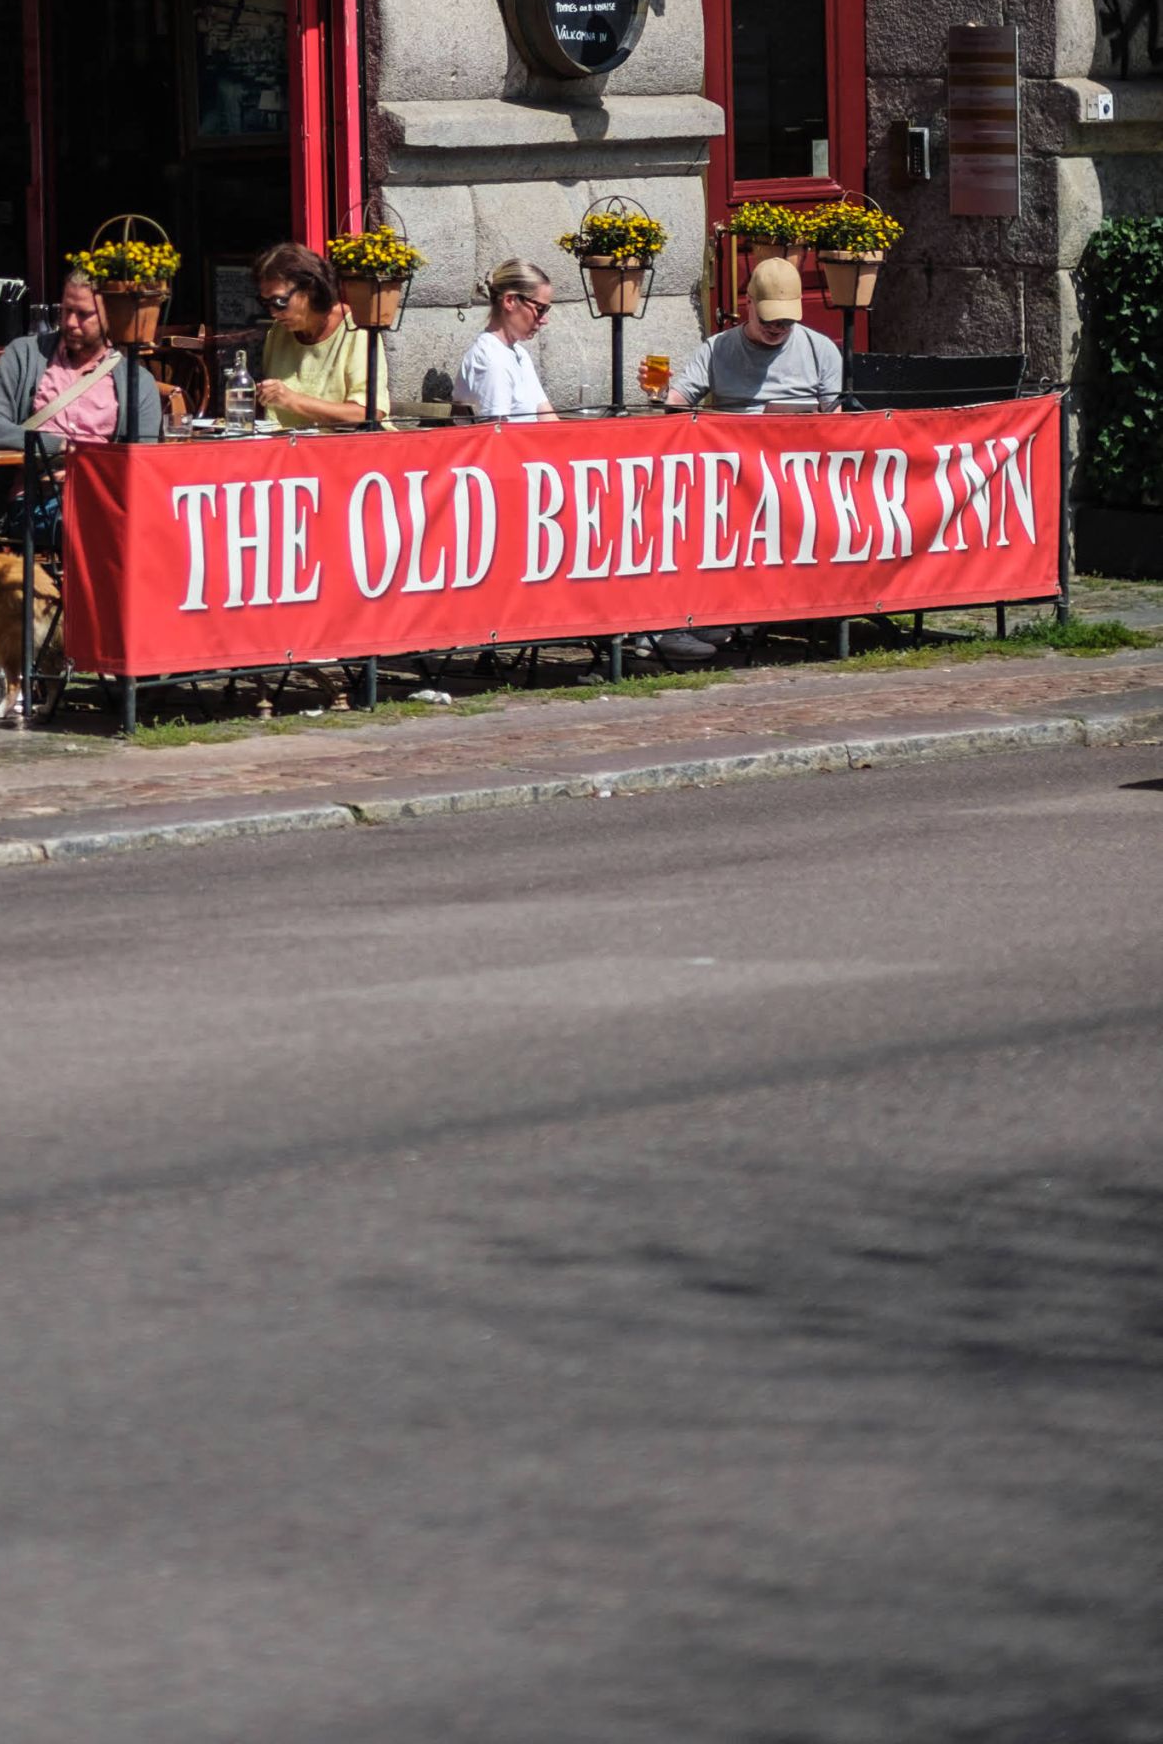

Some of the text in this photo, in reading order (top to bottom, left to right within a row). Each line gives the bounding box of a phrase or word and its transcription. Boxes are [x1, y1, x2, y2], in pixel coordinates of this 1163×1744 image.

[172, 434, 1037, 611] THE OLD BEEFEATER INN
